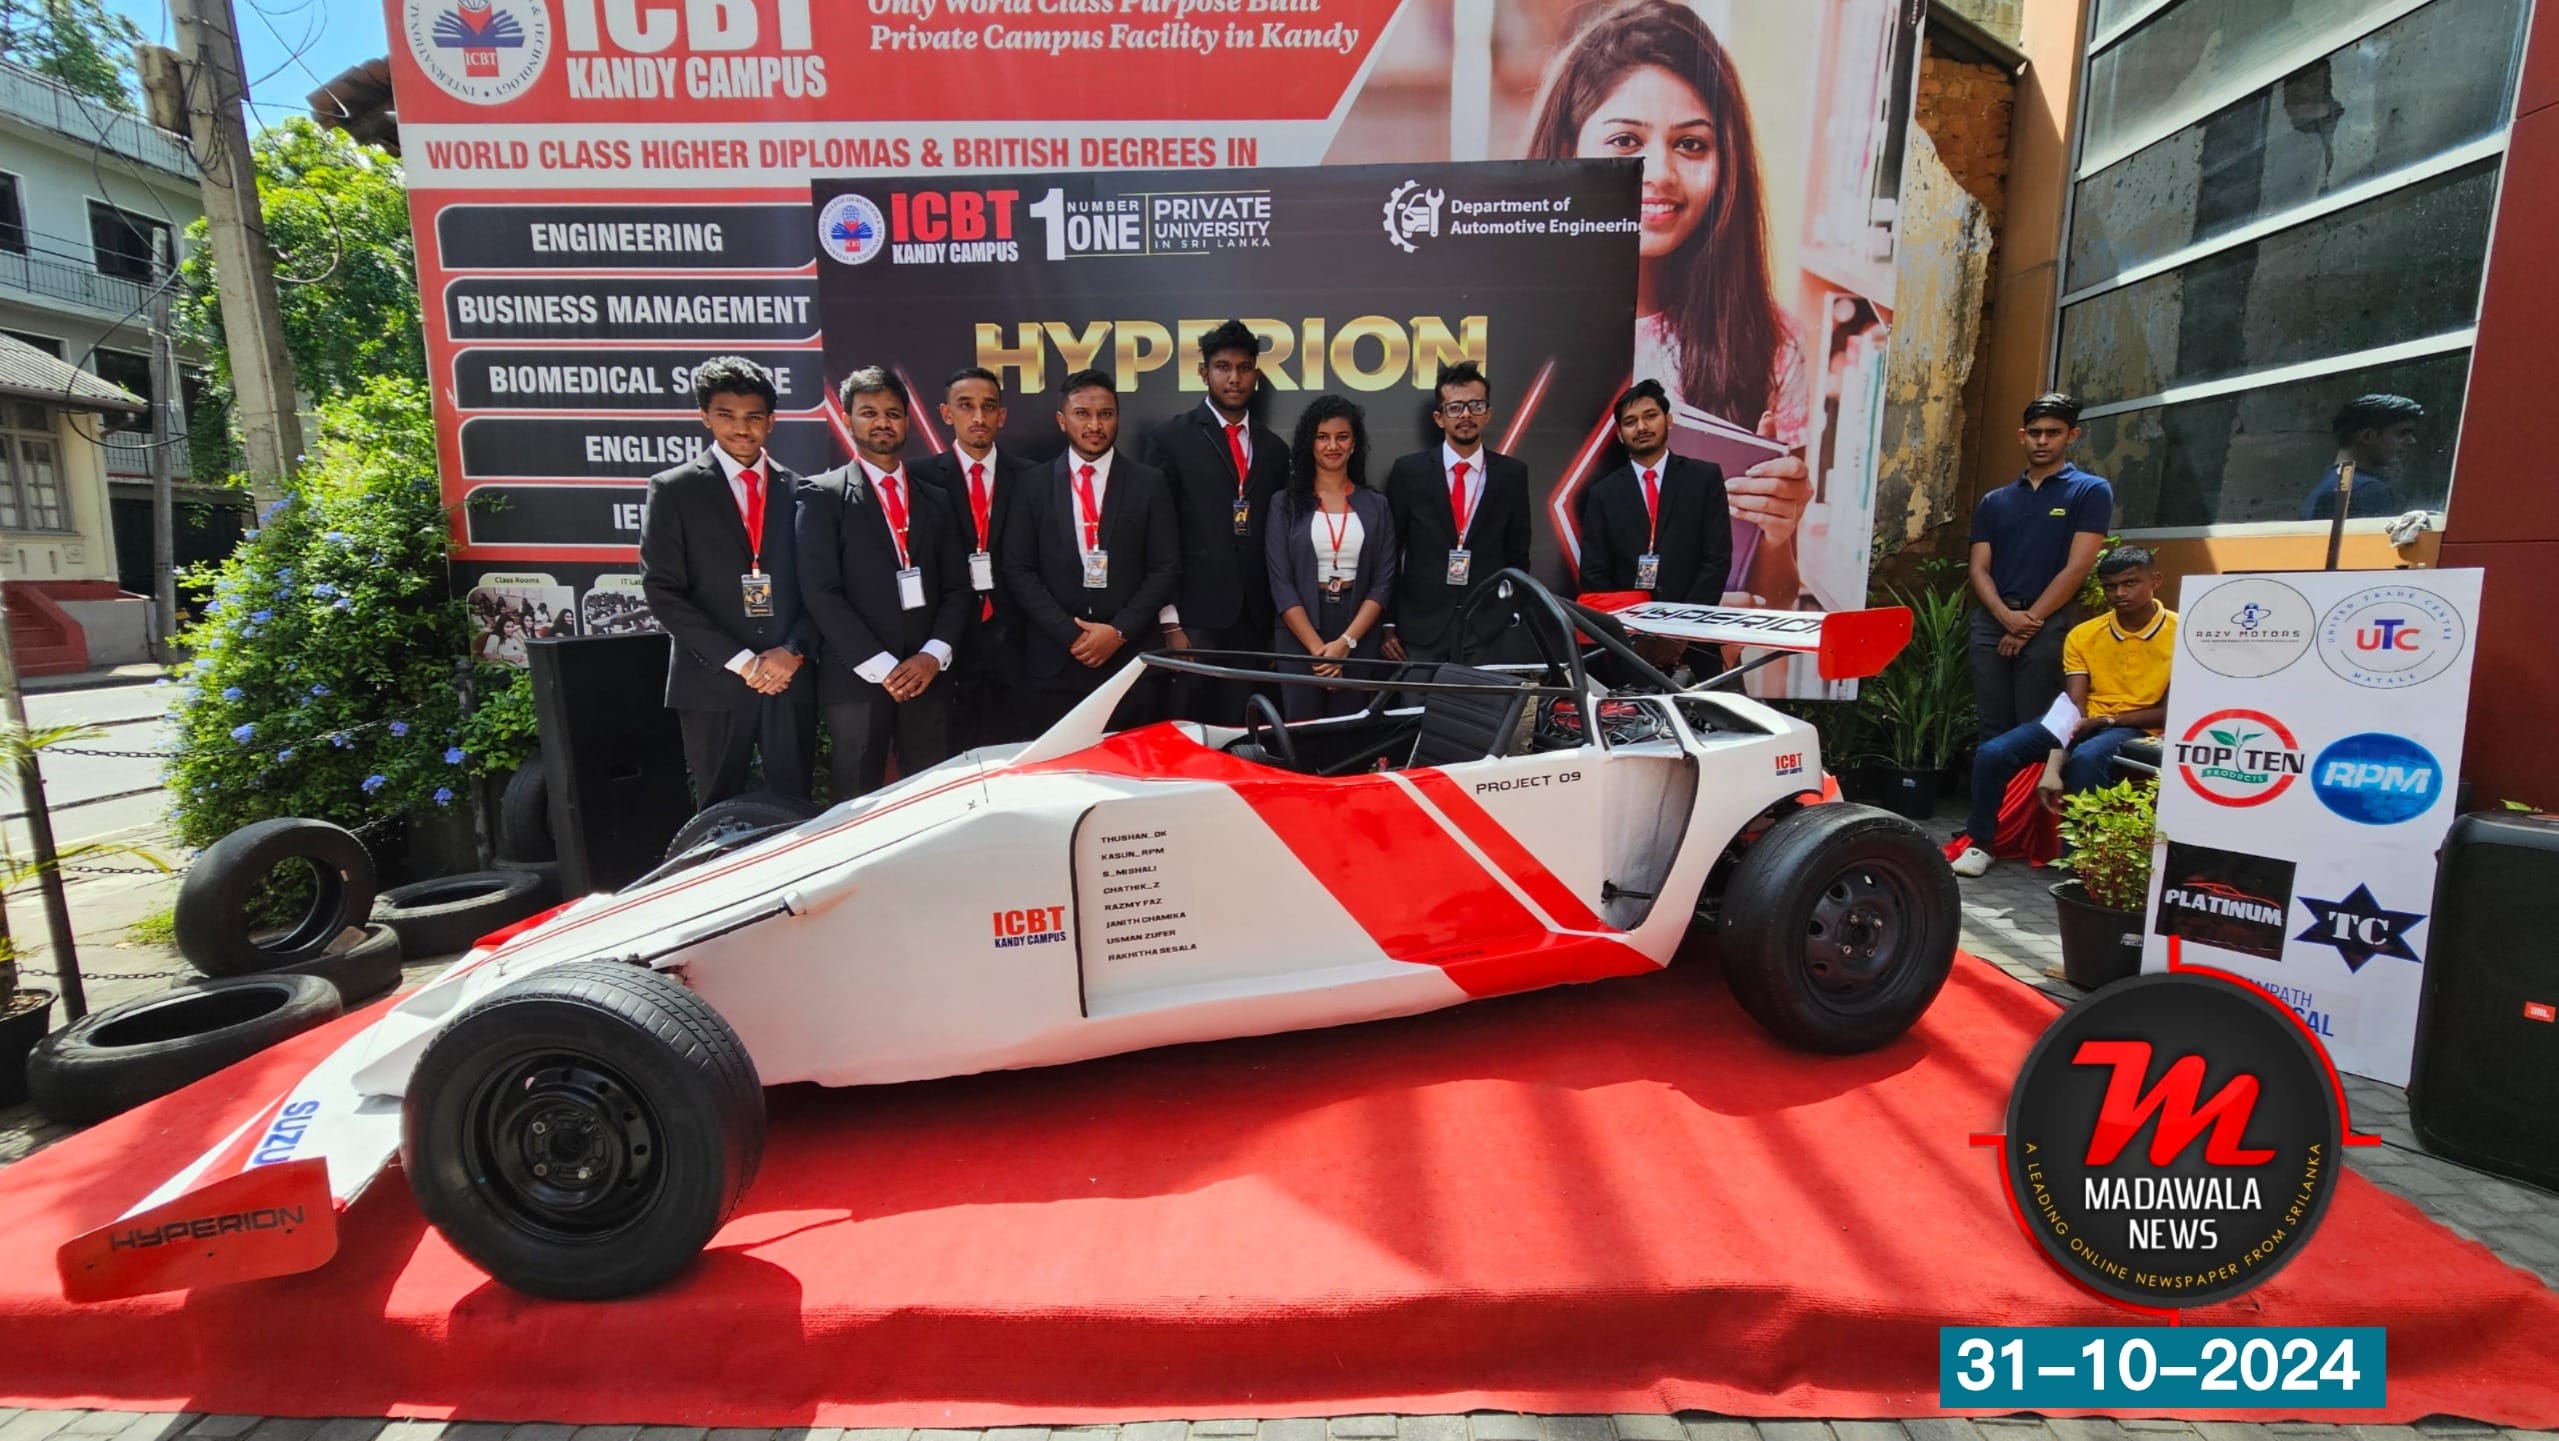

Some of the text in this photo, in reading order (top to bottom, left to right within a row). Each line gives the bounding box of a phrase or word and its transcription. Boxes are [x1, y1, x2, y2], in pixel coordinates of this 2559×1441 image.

[870, 22, 1359, 56] Private Campus Facility in Kandy
[465, 52, 497, 66] ICBT
[566, 55, 827, 98] KANDY CAMPUS
[425, 137, 1258, 169] WORLD CLASS HIGHER DIPLOMAS & BRITISH DEGREES IN
[891, 190, 1019, 242] ICBT
[1067, 200, 1140, 213] NUMBER
[1154, 197, 1271, 220] PRIVATE
[1451, 197, 1572, 216] Department of
[530, 223, 723, 252] ENGINEERING
[1029, 188, 1066, 261] 1
[1067, 214, 1140, 251] ONE
[1154, 221, 1271, 239] UNIVERSITY
[1450, 218, 1642, 236] Automotive Engineerin
[892, 241, 1019, 264] KANDY CAMPUS
[1155, 238, 1271, 249] IN SRI LANKA
[457, 295, 810, 324] BUSINESS MANAGEMENT
[489, 366, 663, 394] BIOMEDICAL
[585, 436, 703, 463] ENGLISH
[494, 576, 514, 584] Class
[2328, 591, 2451, 644] UNITED TRADE CENTRE
[2239, 630, 2301, 638] MOTORS
[2353, 672, 2417, 684] MATALE
[1775, 752, 1803, 770] ICBT
[2175, 744, 2305, 774] TOP TEN
[1476, 771, 1581, 795] PROJECT 09
[2206, 768, 2264, 783] PRODUCTS
[2322, 761, 2432, 794] RPM
[993, 905, 1065, 937] ICBT
[2165, 888, 2282, 927] PLATINUM
[994, 931, 1066, 949] KANDY CAMPUS
[2328, 911, 2390, 946] TC
[109, 1204, 305, 1252] HYPERION
